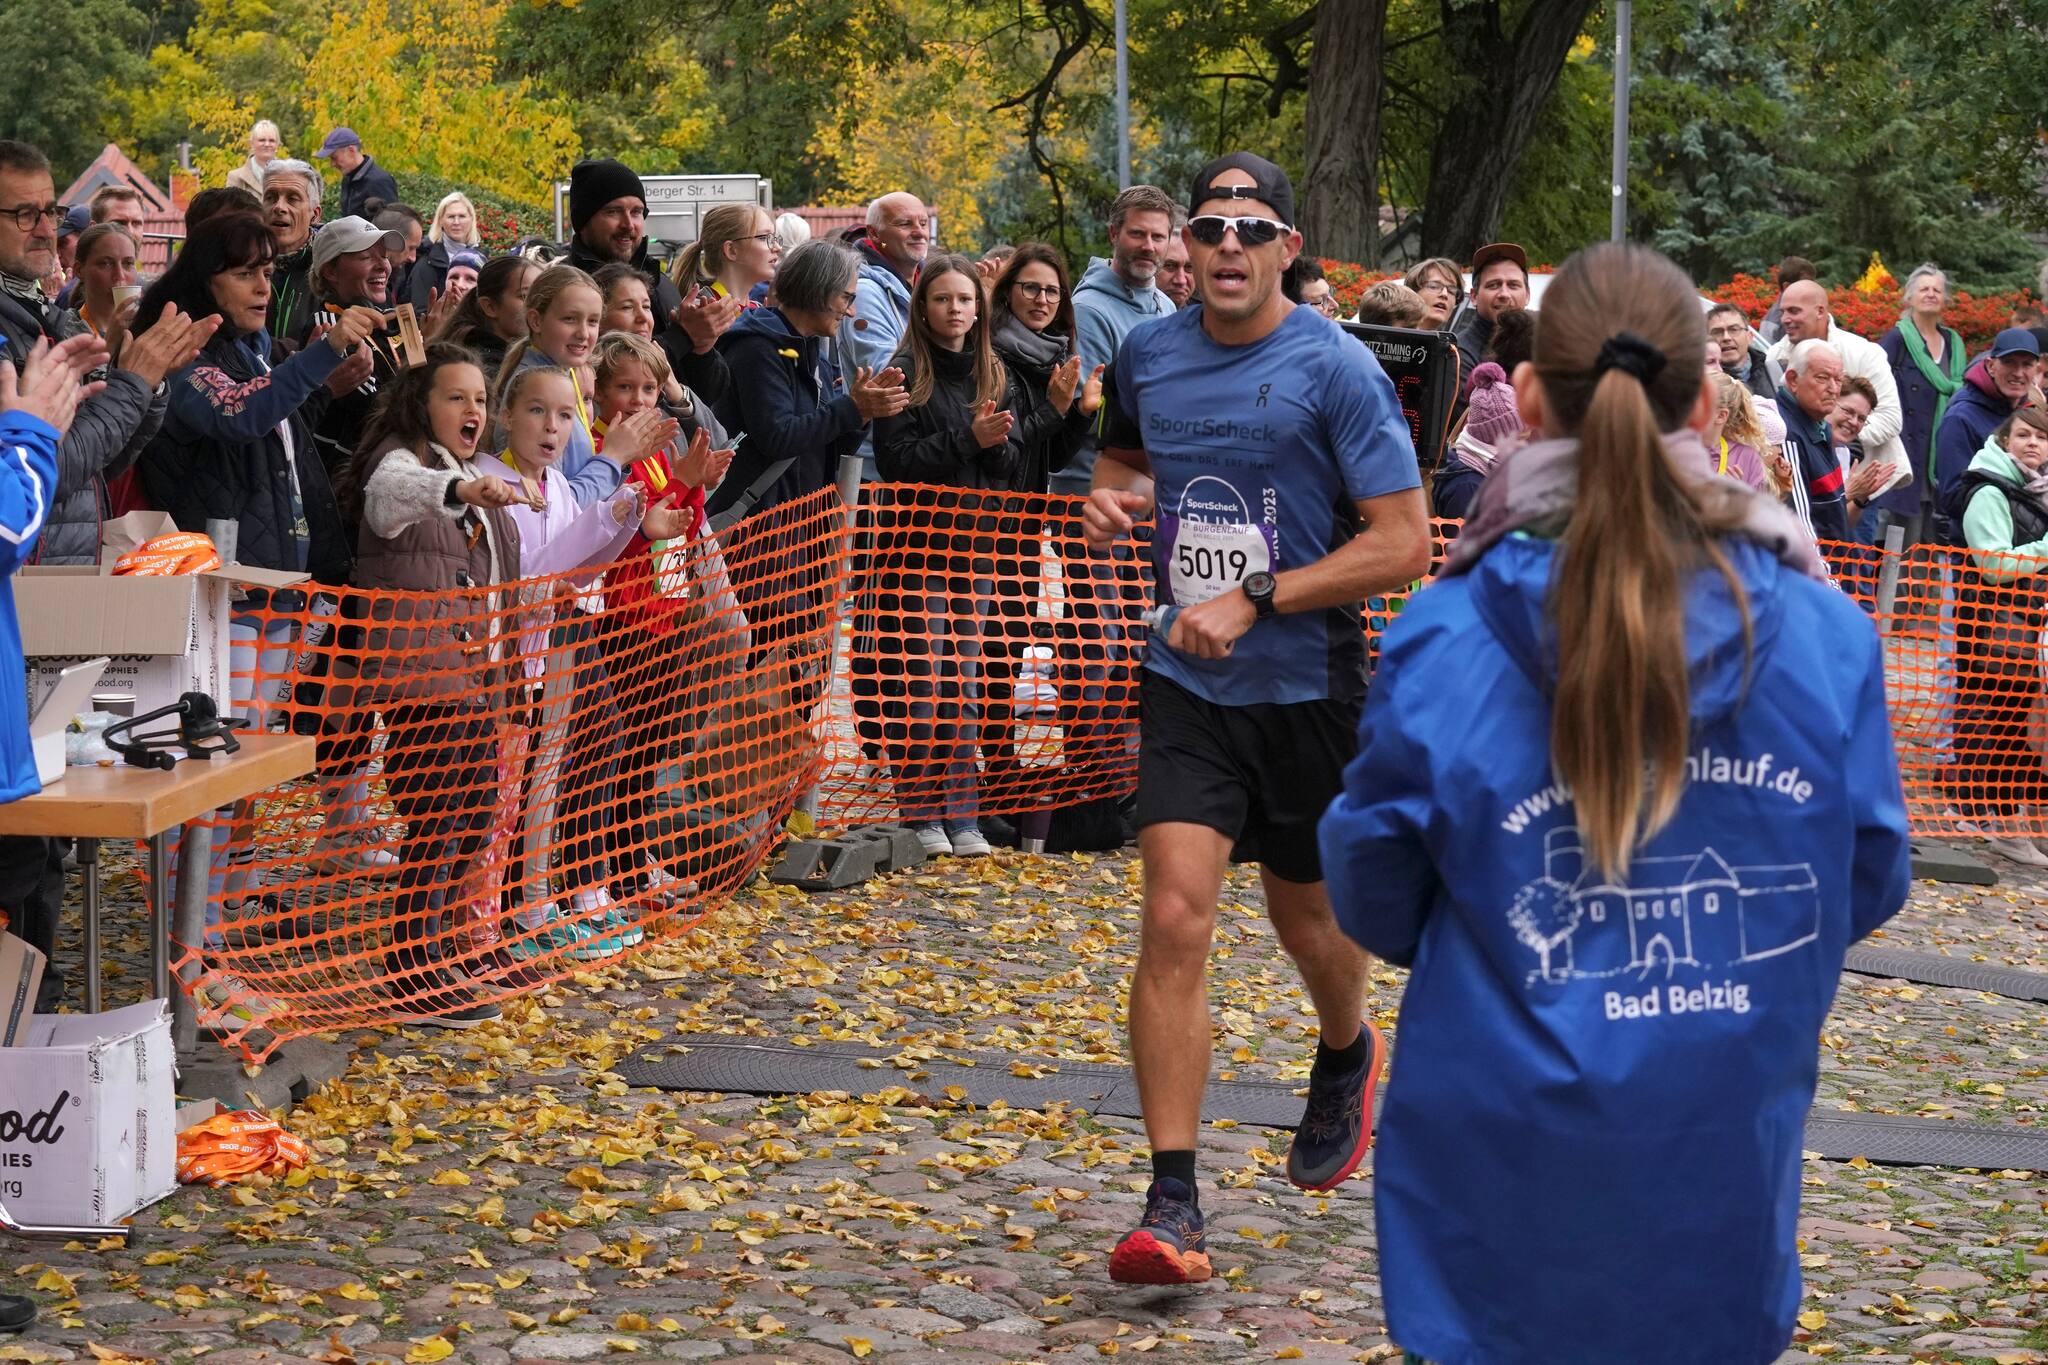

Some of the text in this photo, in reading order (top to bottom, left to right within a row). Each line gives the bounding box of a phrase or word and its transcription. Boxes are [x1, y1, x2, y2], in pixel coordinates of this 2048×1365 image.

[687, 185, 706, 196] Str.
[711, 185, 725, 195] 14
[1382, 343, 1412, 356] TIMING
[1150, 413, 1277, 442] SportScheck
[1187, 499, 1238, 512] SportScheck
[1263, 488, 1276, 525] 2023
[1193, 523, 1250, 535] BURGENLAUF
[1179, 544, 1247, 583] 5019
[1604, 979, 1751, 1021] Bad Belzig
